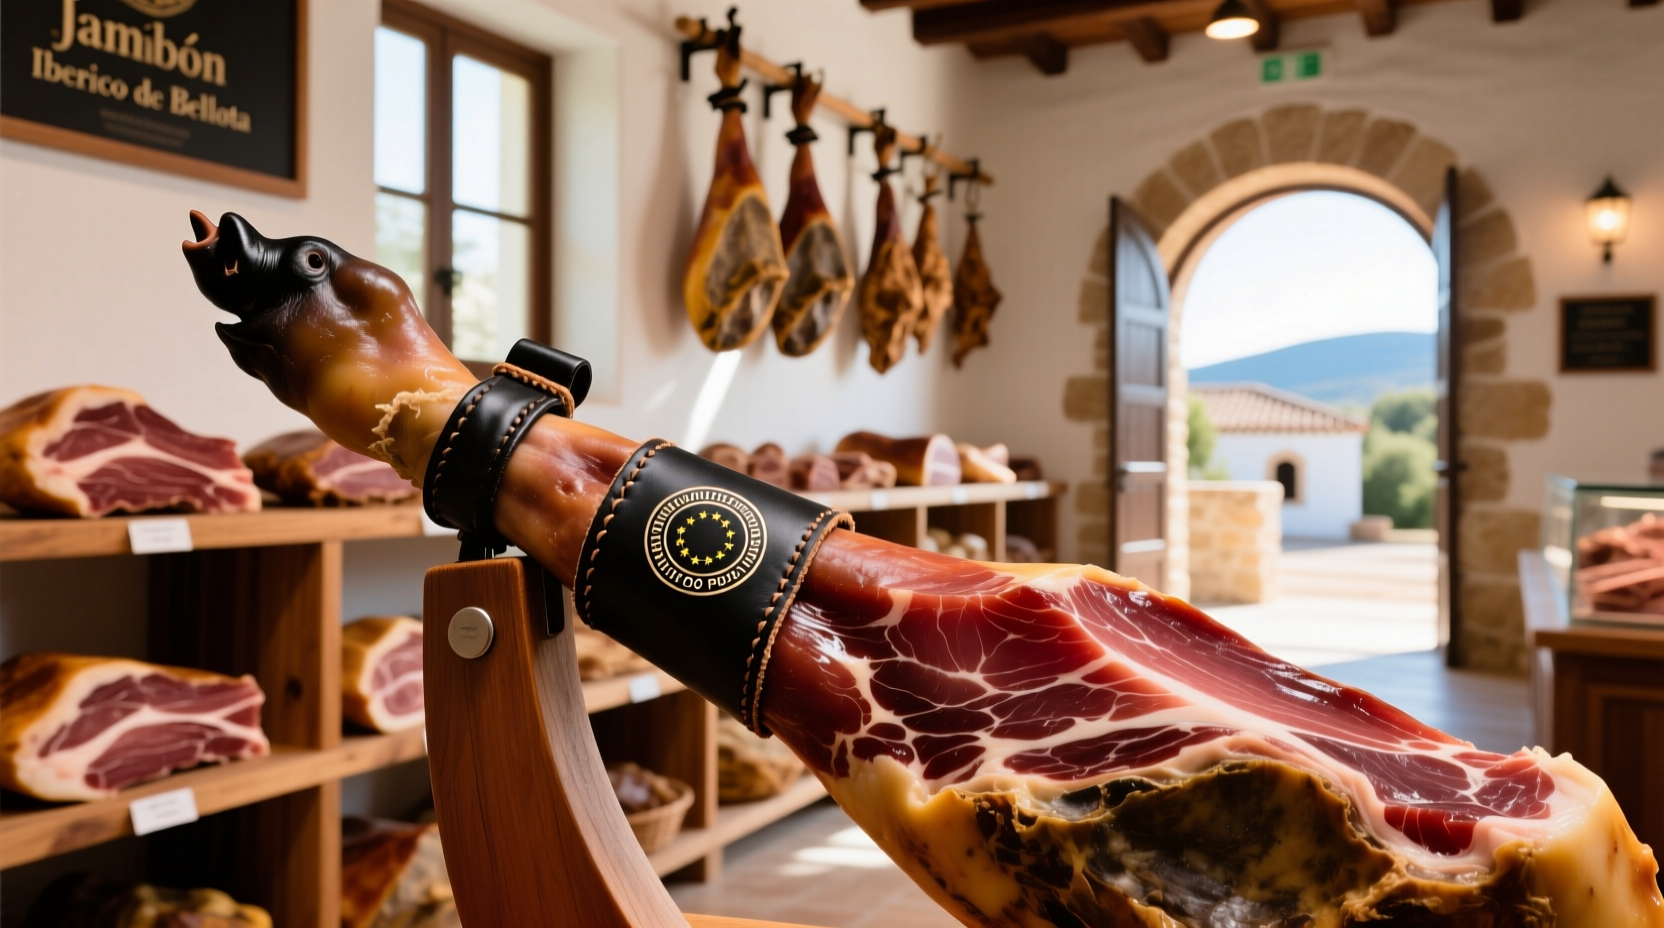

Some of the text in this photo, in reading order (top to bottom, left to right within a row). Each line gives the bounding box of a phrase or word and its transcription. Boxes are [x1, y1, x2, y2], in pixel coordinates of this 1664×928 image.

[32, 46, 129, 101] Iberico
[133, 78, 164, 111] de
[169, 84, 251, 133] Bellota
